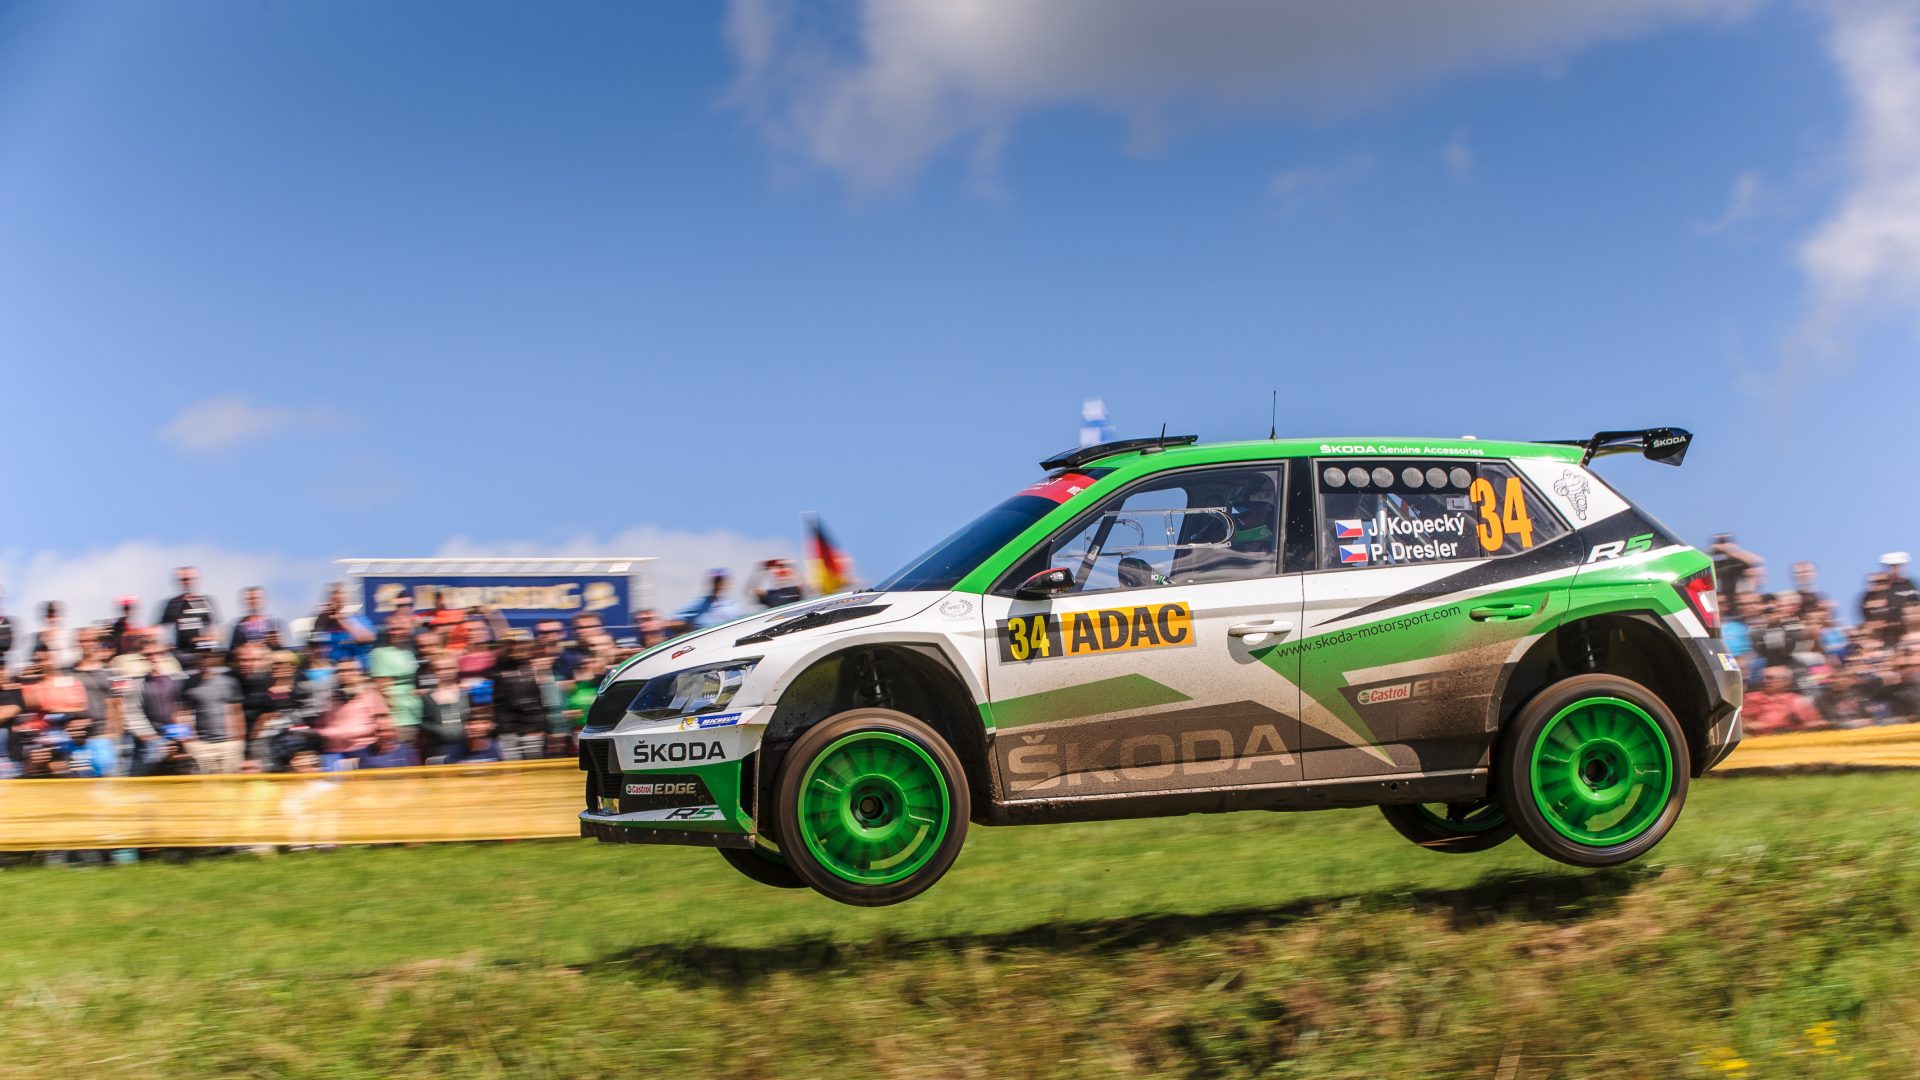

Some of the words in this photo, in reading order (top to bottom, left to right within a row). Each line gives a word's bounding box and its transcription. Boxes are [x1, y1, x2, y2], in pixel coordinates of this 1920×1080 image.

[1320, 444, 1378, 454] ŠKODA
[1379, 445, 1421, 454] Genuine
[1423, 446, 1485, 456] Accessories
[1653, 436, 1687, 448] ŠKODA
[1367, 519, 1385, 537] J.
[1388, 512, 1465, 538] Kopecký
[1470, 477, 1533, 551] 34
[1371, 544, 1388, 561] P.
[1393, 539, 1458, 560] Dresler
[1586, 533, 1654, 564] R5
[1007, 615, 1050, 661] 34
[1071, 603, 1188, 653] ADAC
[1276, 605, 1461, 658] www.skoda-motorsport.com
[1370, 687, 1408, 702] Castrol
[702, 715, 740, 725] MICHELIN
[633, 740, 727, 763] ŠKODA
[1008, 724, 1296, 792] ŠKODA
[631, 785, 652, 794] Castrol
[654, 783, 697, 795] EDGE
[665, 808, 716, 820] R5
